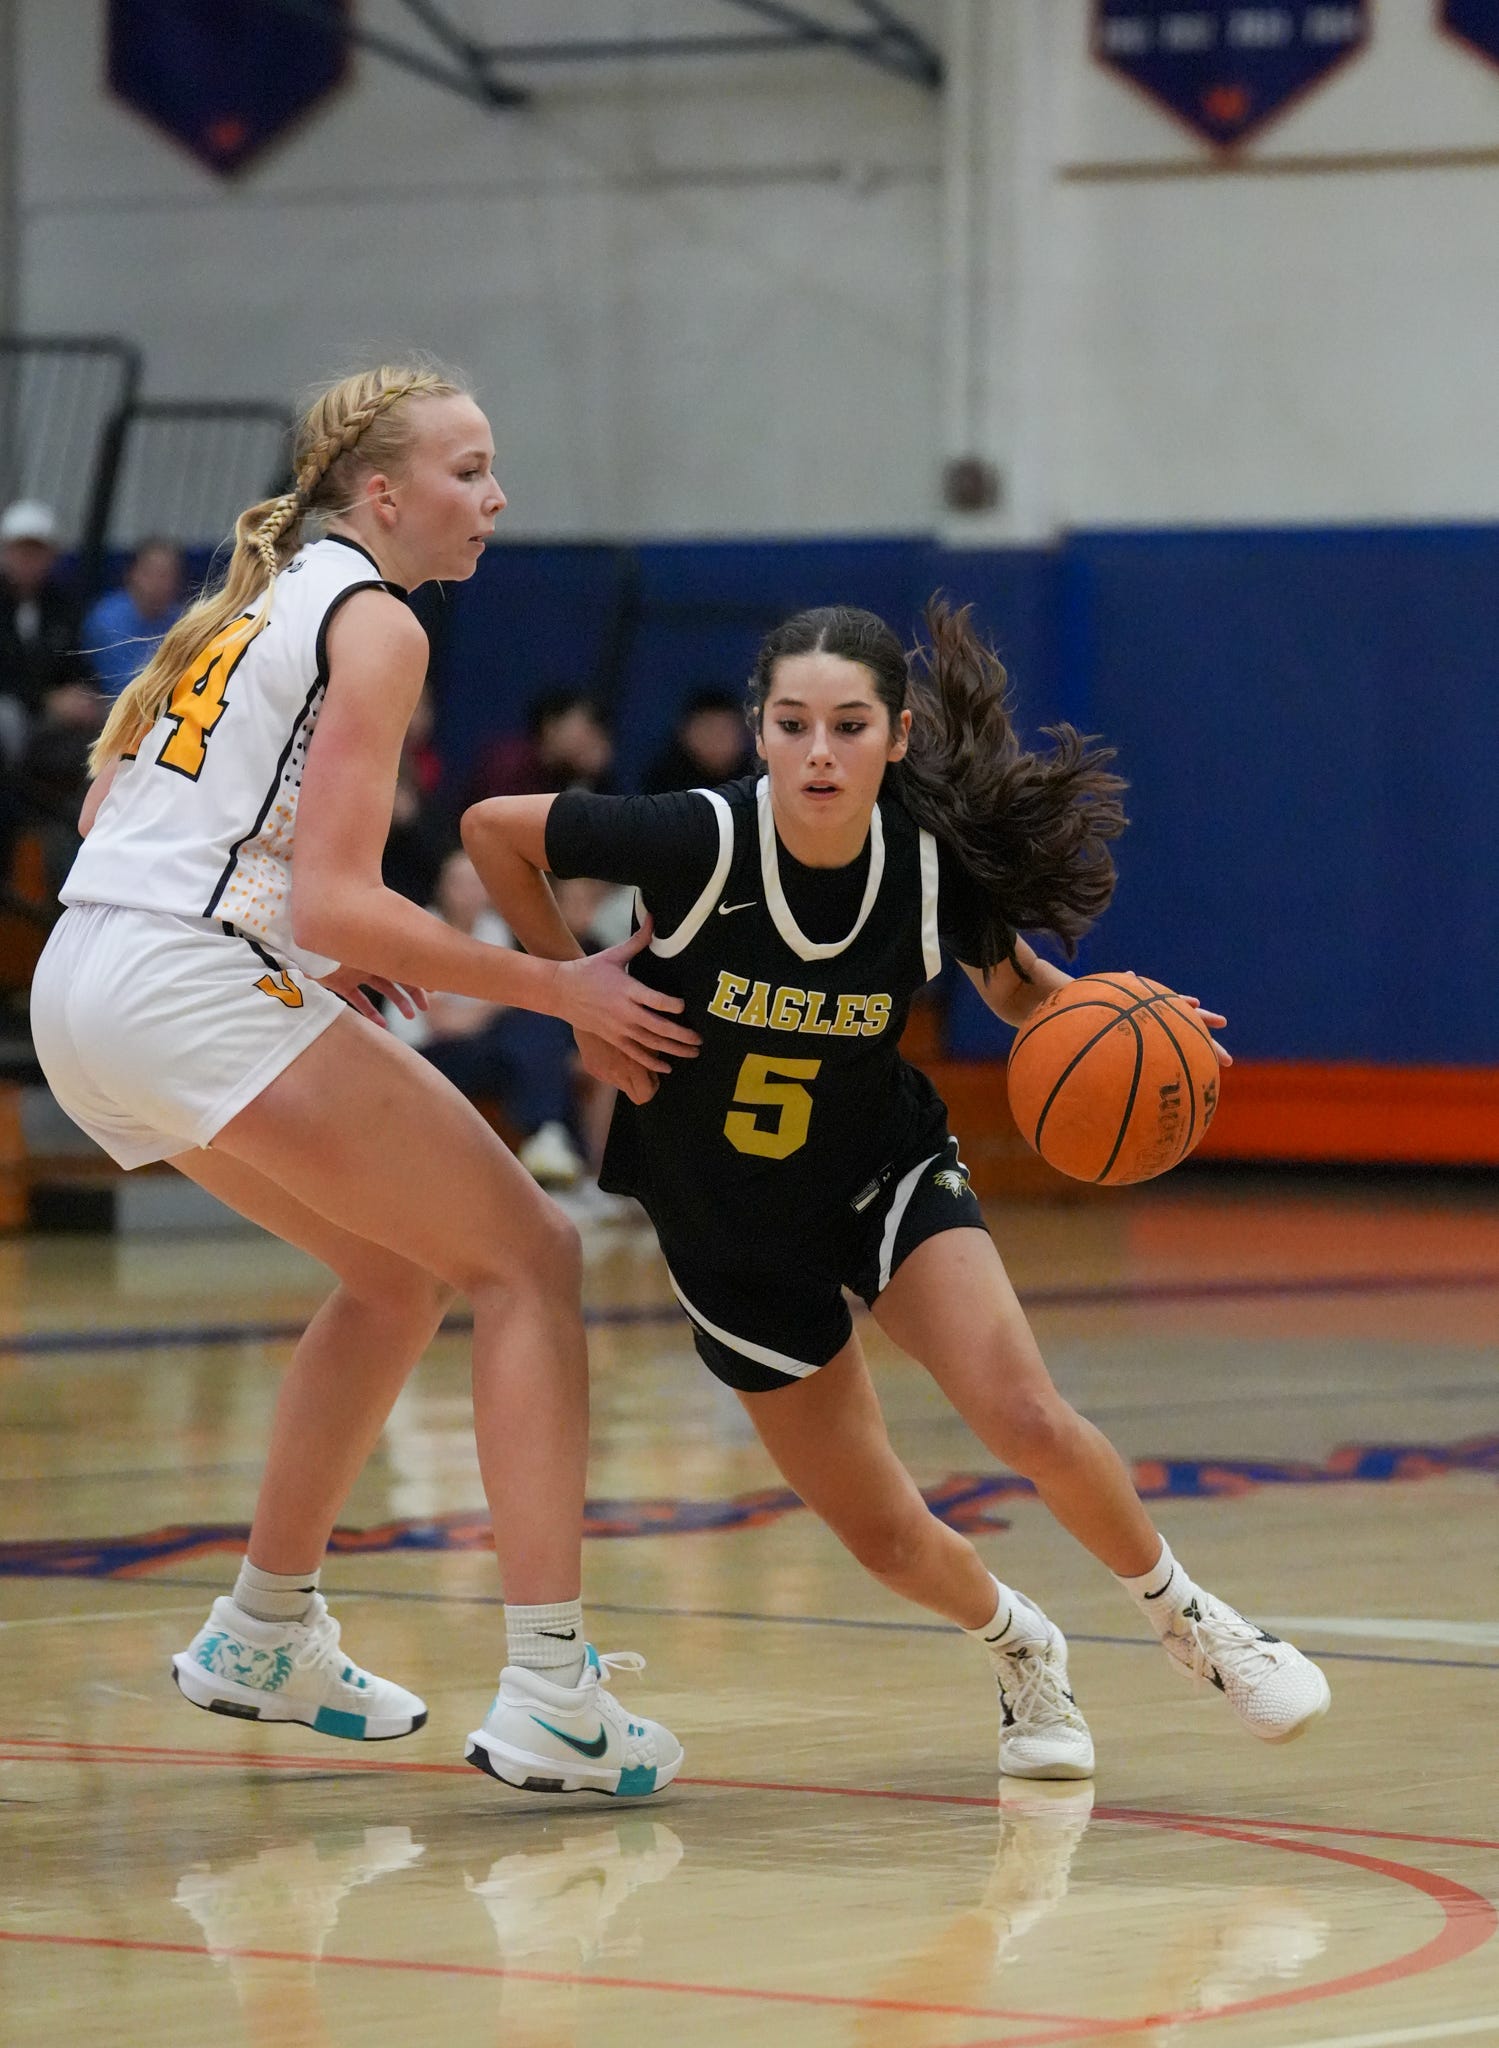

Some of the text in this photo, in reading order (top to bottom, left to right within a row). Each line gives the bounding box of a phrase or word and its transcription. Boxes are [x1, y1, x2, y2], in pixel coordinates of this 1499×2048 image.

[120, 613, 271, 782] 4
[707, 970, 892, 1036] EAGLES
[723, 1053, 822, 1160] 5
